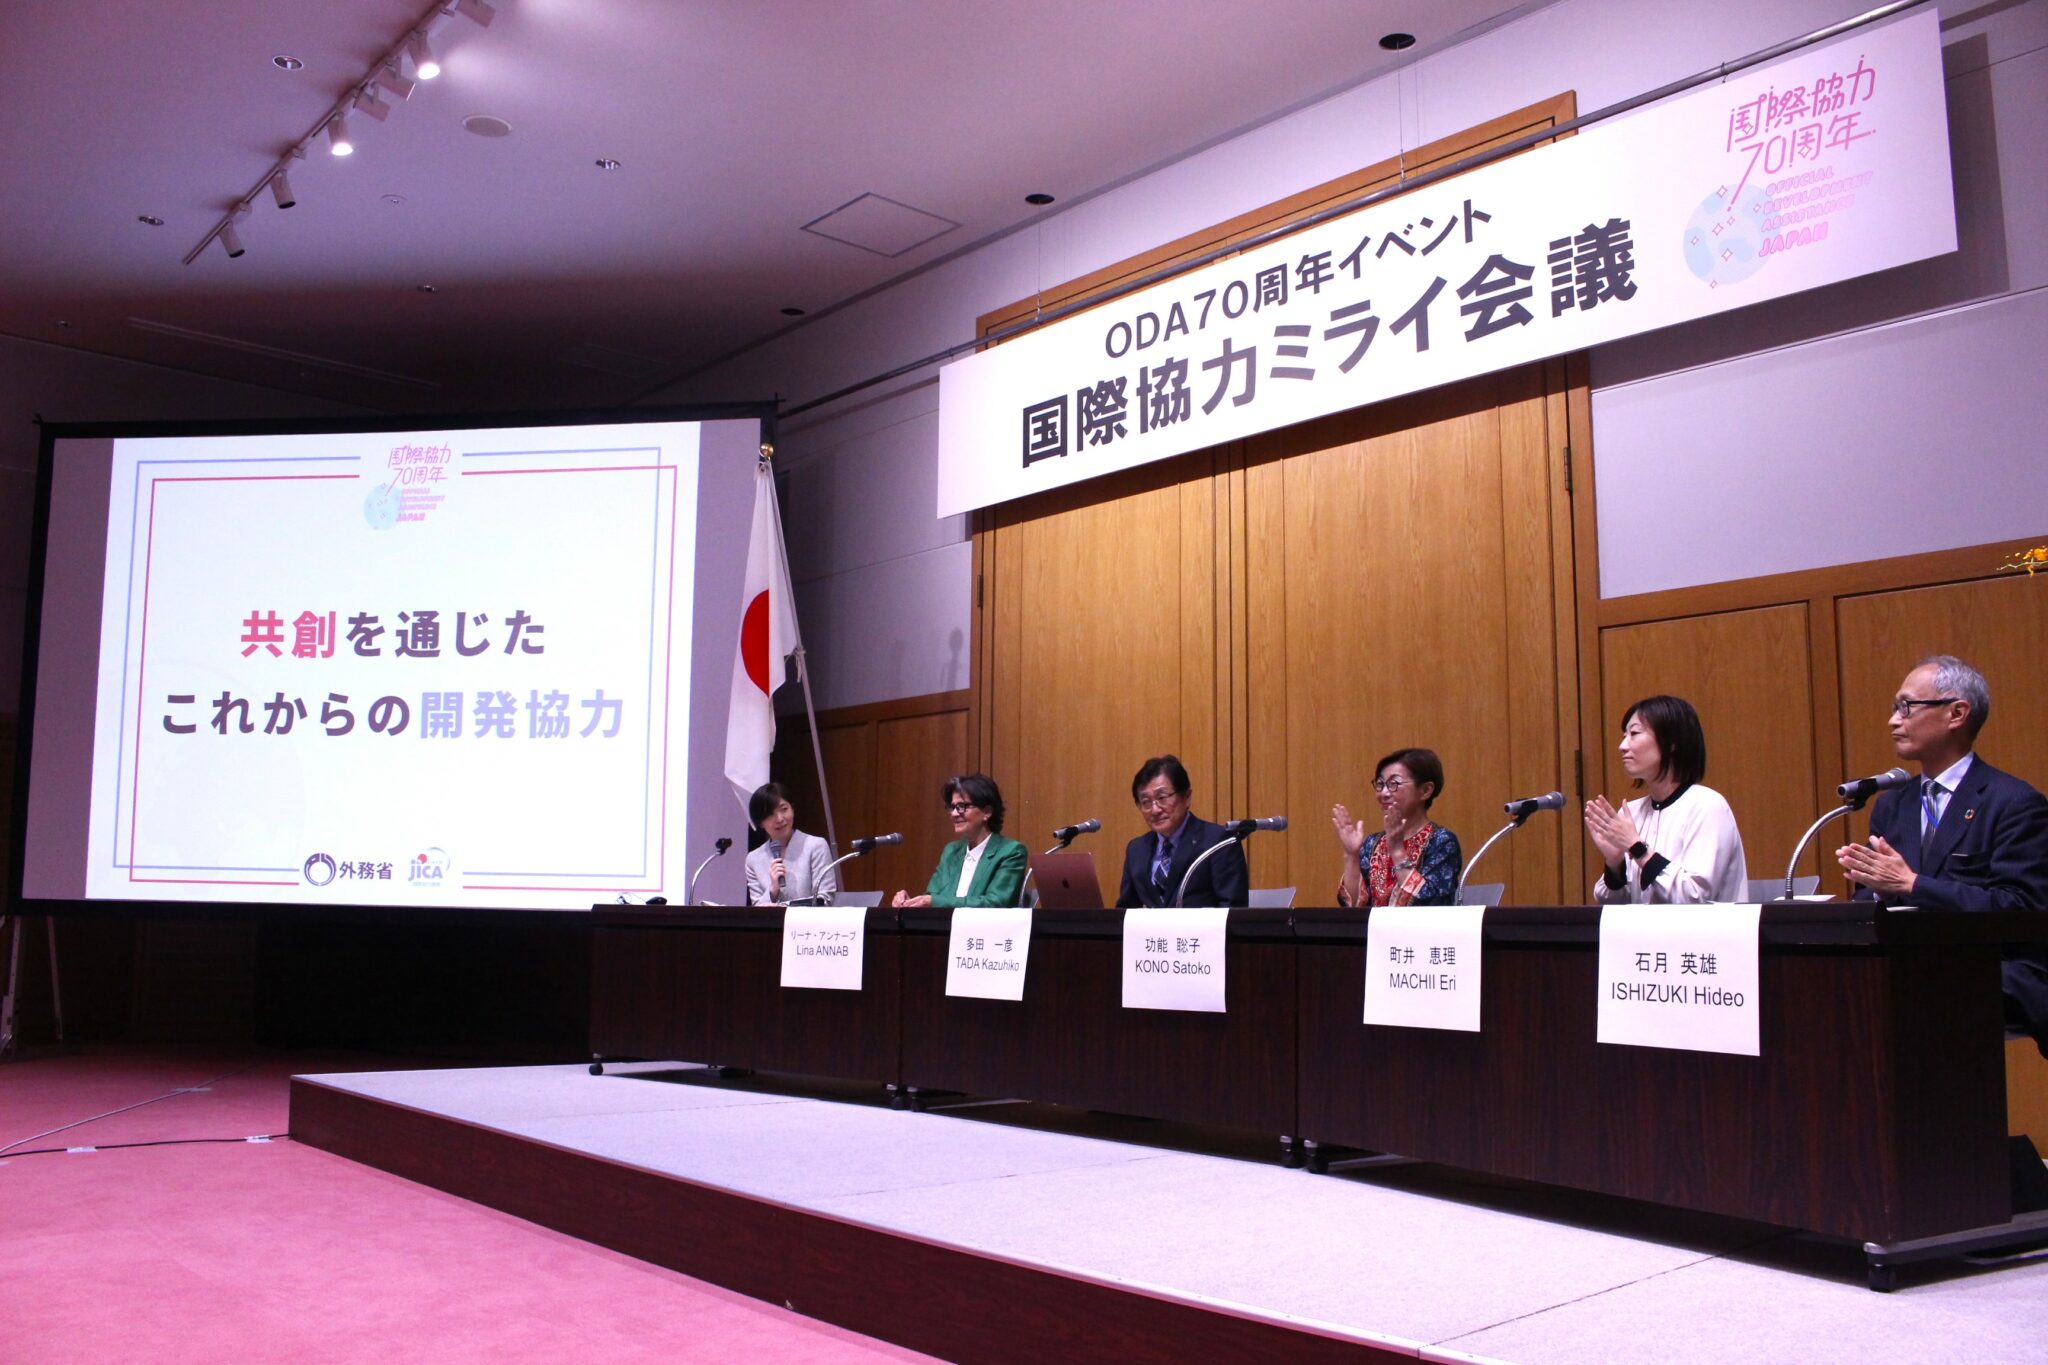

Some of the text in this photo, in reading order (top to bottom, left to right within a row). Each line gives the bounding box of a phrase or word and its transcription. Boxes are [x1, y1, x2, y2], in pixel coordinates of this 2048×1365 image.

[1726, 54, 1876, 152] 国際協力
[1758, 222, 1829, 258] JAPAN
[1105, 199, 1492, 359] ODA70周年イベント
[1022, 217, 1639, 468] 国際協力ミライ会議
[240, 609, 546, 659] 共創を通じた
[162, 689, 625, 740] これからの開発協力
[339, 861, 393, 880] 外務省
[796, 945, 849, 957] Lina ANNAB
[966, 937, 984, 951] 多田
[1145, 937, 1201, 953] 功能 聡子
[956, 956, 1020, 972] TADA Kazuhiko
[1390, 946, 1456, 965] 町井 恵理
[1635, 952, 1717, 975] 石月 英雄
[1135, 959, 1211, 975] KONO Satoko
[1389, 972, 1456, 991] MACHII Eri
[1611, 982, 1745, 1008] ISHIZUKI Hideo
